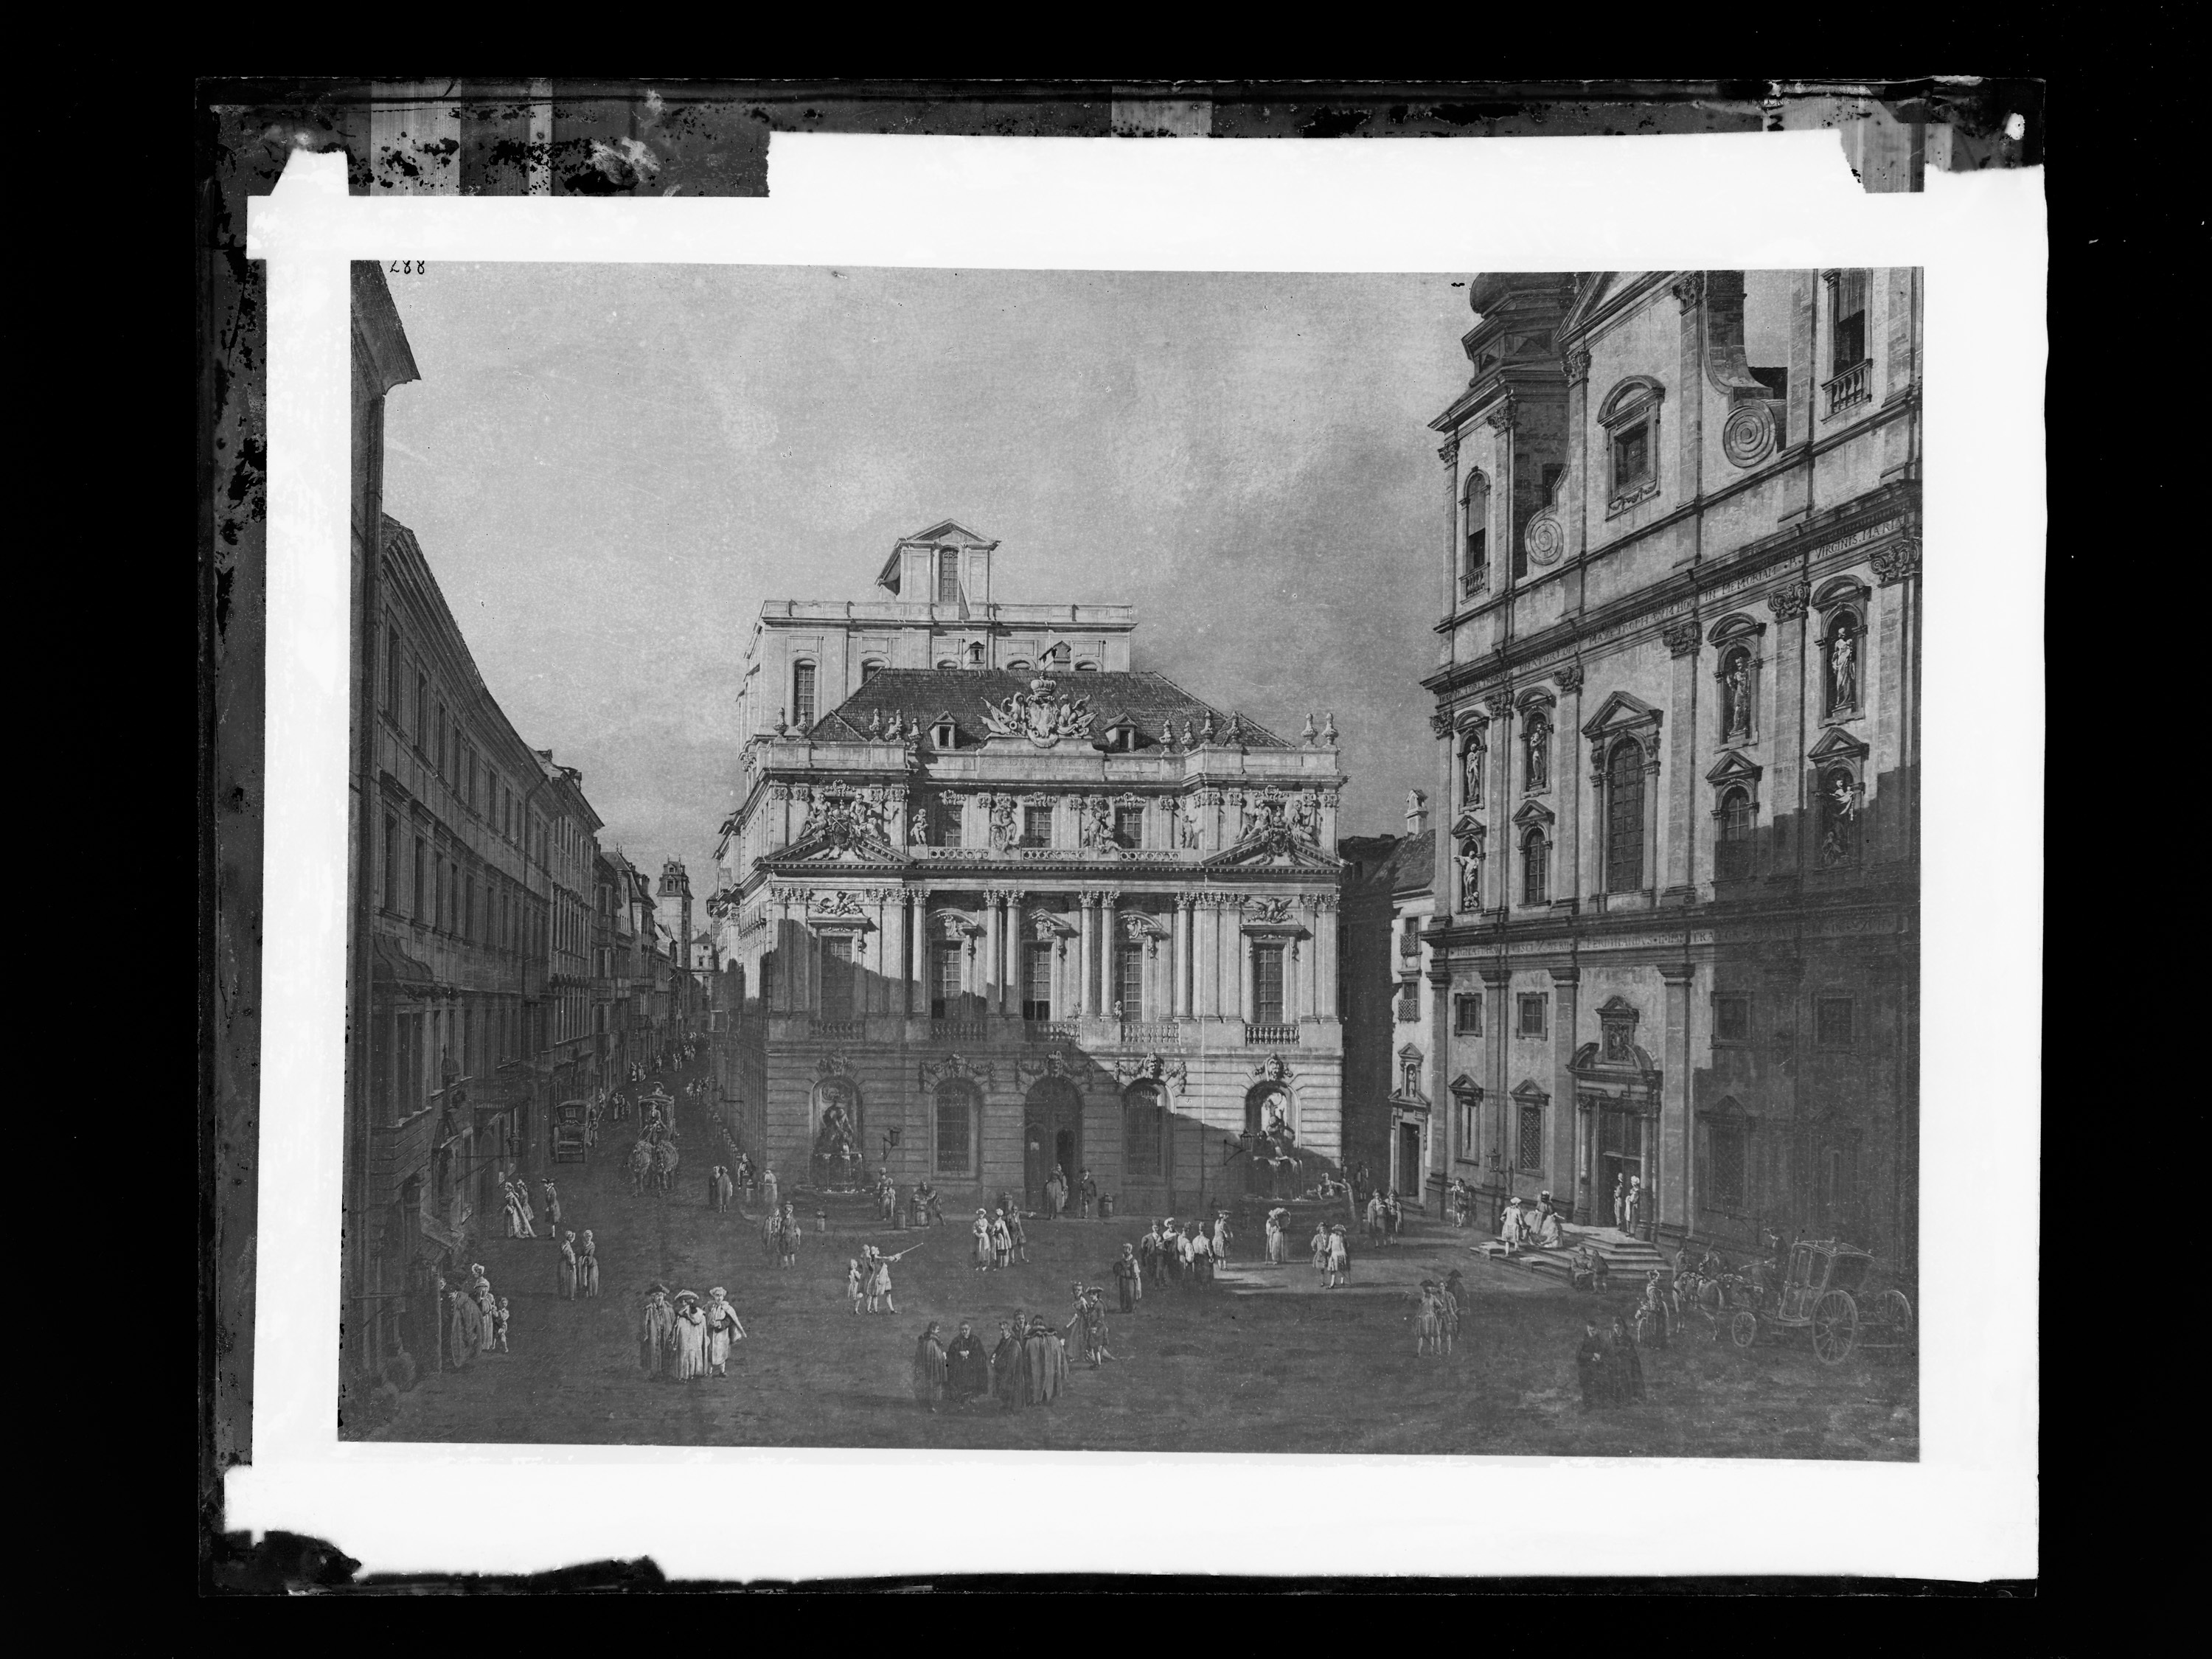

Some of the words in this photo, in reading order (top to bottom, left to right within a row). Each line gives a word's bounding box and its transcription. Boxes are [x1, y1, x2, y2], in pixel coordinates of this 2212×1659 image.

[1677, 598, 1695, 613] HOC
[1705, 591, 1717, 601] IN
[1722, 566, 1777, 595] MEMORIAM
